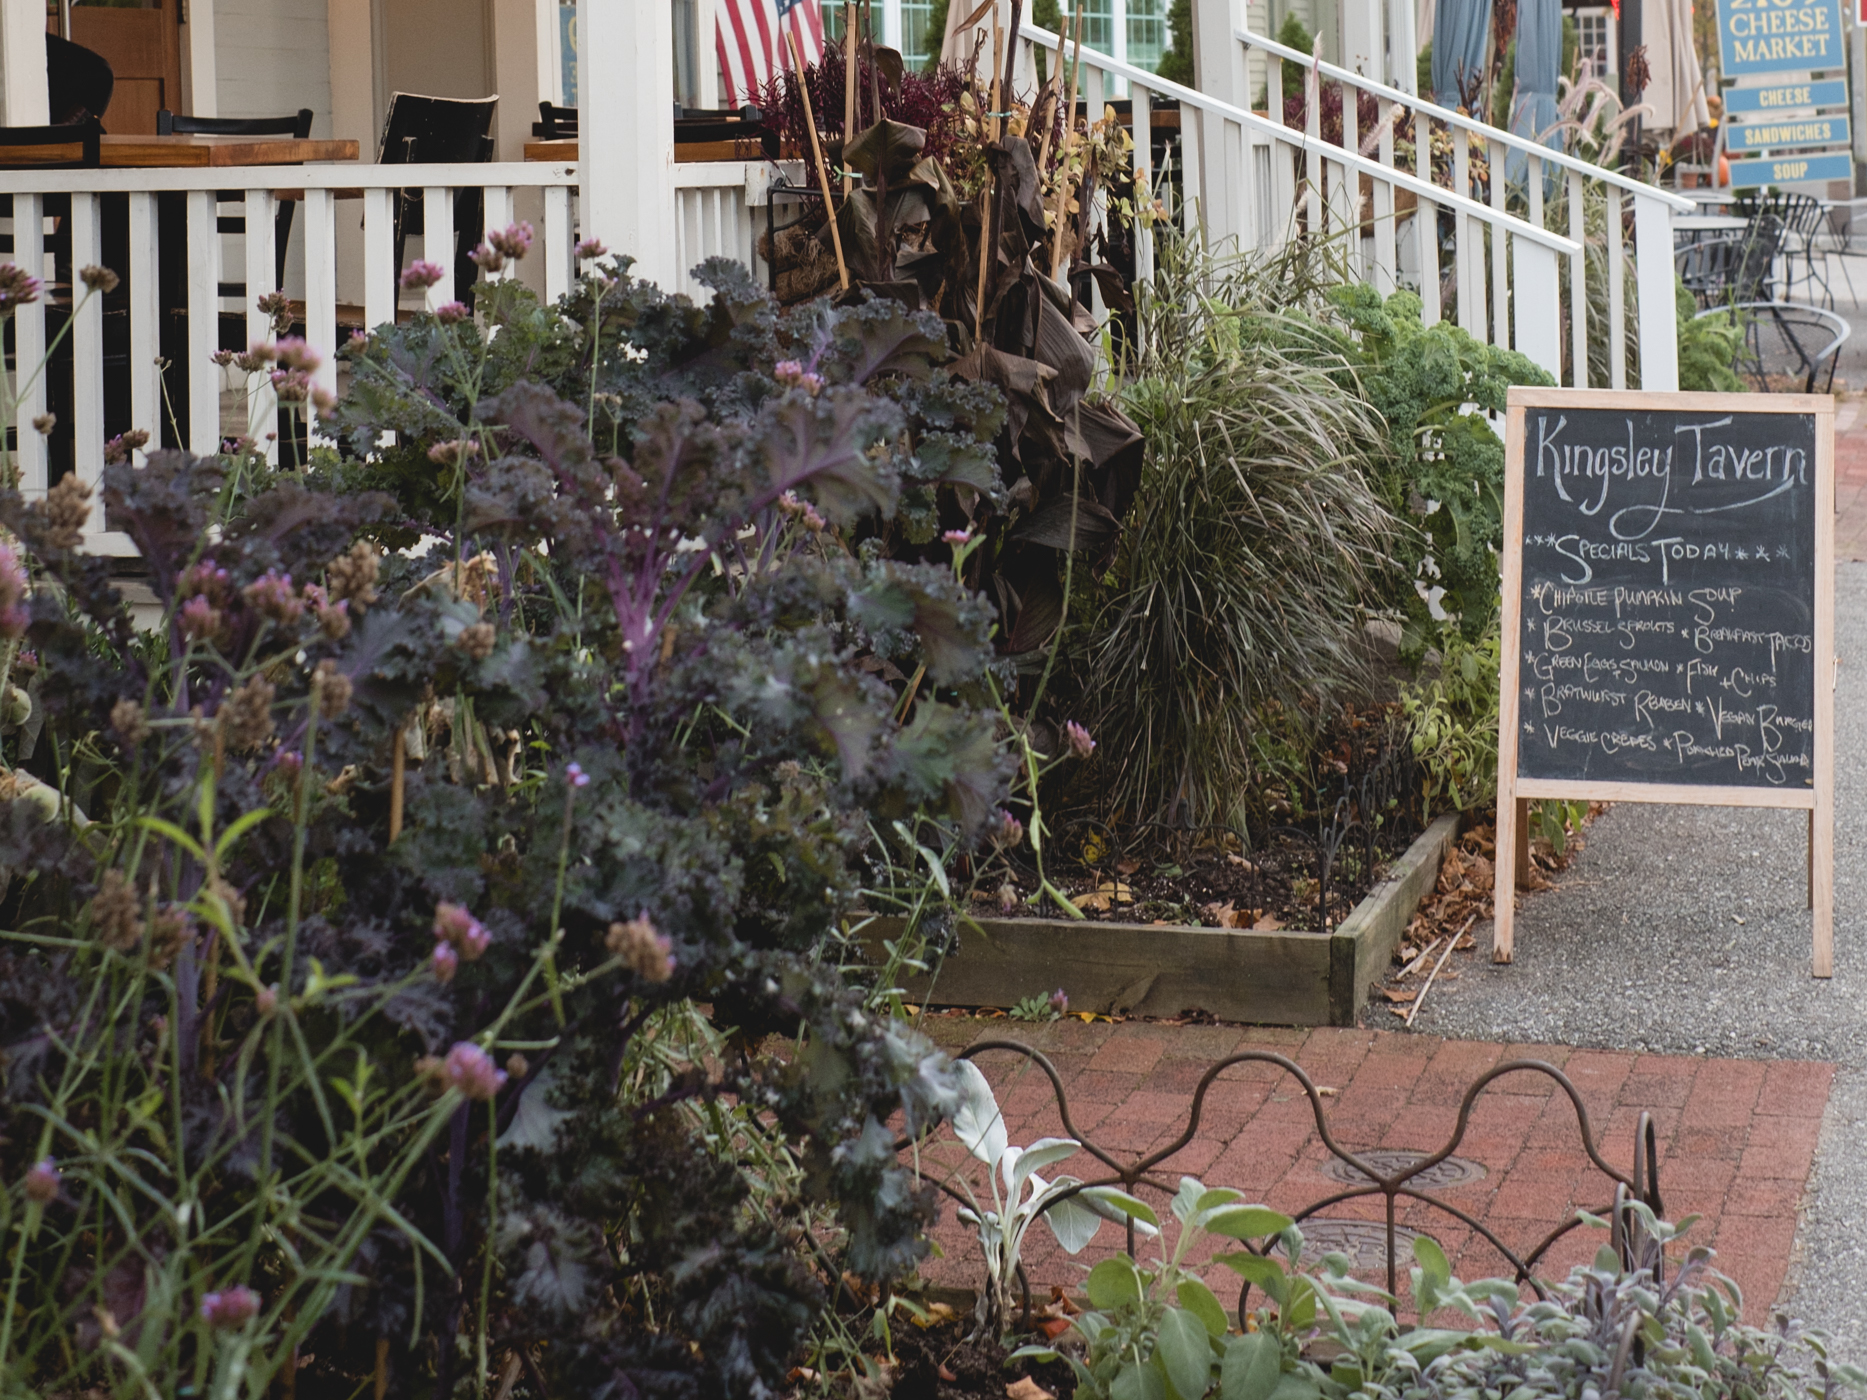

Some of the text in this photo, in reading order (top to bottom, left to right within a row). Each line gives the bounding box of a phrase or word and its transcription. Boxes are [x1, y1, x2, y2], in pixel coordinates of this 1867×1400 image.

[1729, 7, 1829, 37] CHEESE
[1734, 34, 1830, 63] MARKET
[1759, 87, 1811, 107] CHEESE
[1745, 122, 1831, 145] SANDWICHES
[1773, 162, 1808, 180] SOUP
[1537, 415, 1808, 540] Kingsley Tavern
